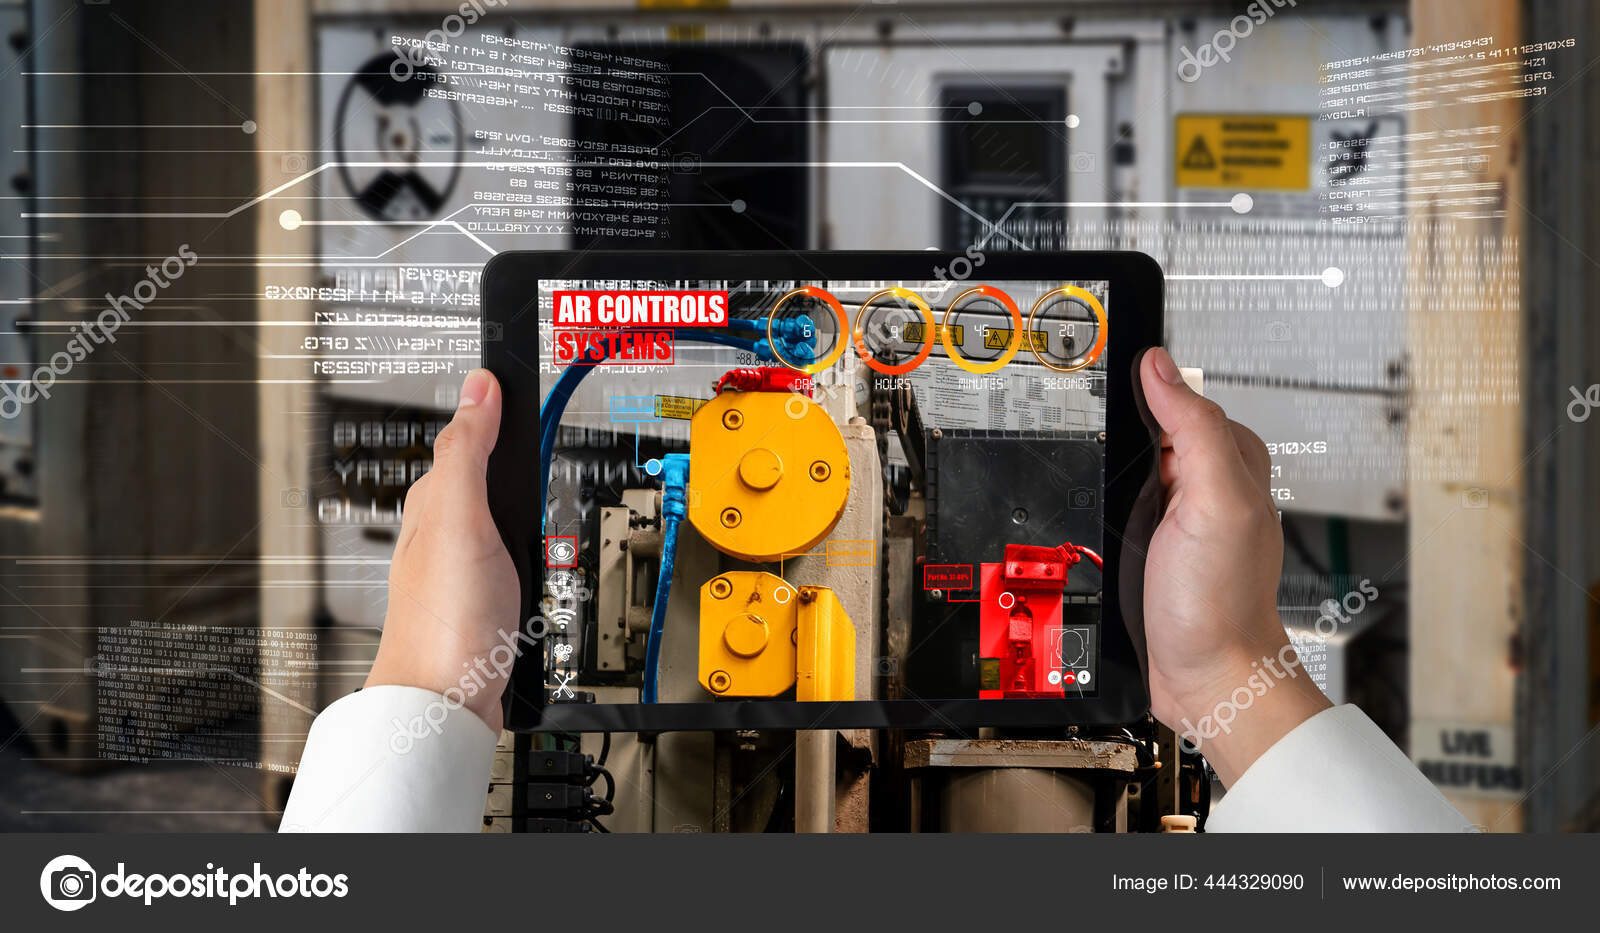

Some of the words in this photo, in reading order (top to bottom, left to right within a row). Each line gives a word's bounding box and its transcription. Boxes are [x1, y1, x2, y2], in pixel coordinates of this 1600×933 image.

[558, 295, 591, 323] AR
[598, 295, 725, 323] CONTROLS
[803, 325, 812, 337] 6
[891, 325, 899, 338] 9
[1059, 324, 1074, 337] 20
[558, 332, 671, 360] SYSTEMS
[795, 379, 816, 390] DAY
[875, 379, 911, 390] HOURS
[959, 378, 1003, 390] MINUTES
[1044, 378, 1092, 390] SECONDS
